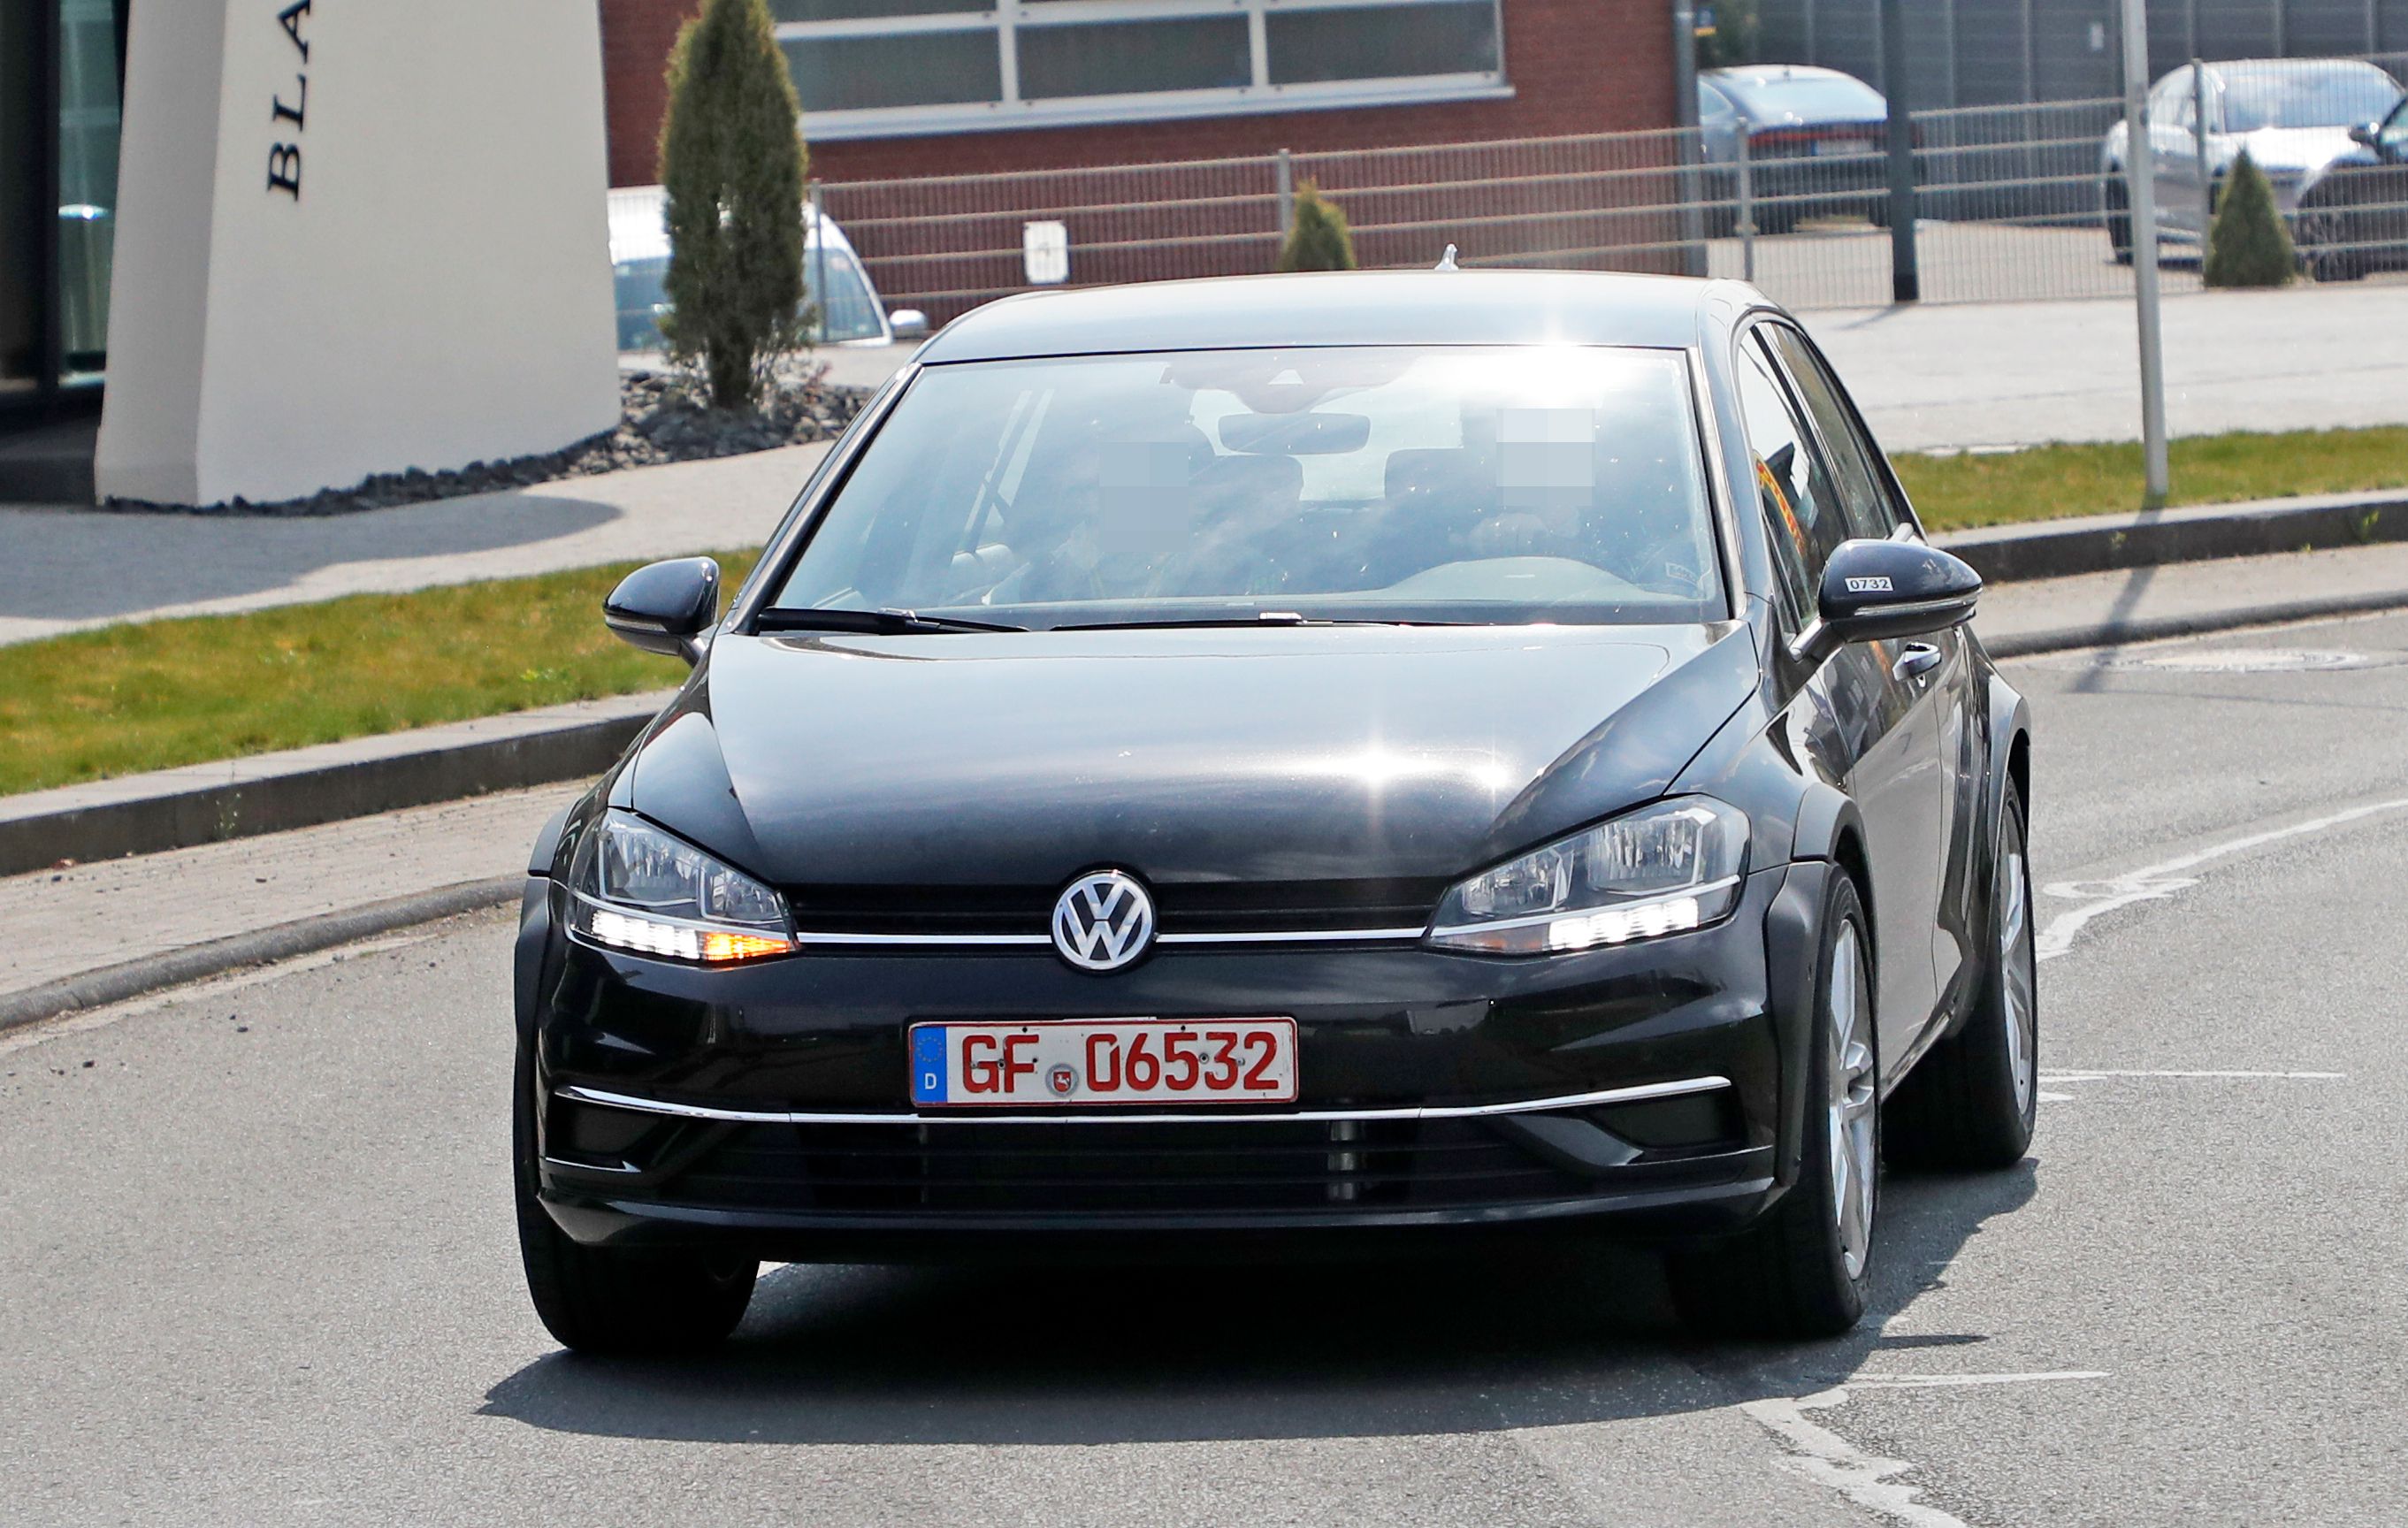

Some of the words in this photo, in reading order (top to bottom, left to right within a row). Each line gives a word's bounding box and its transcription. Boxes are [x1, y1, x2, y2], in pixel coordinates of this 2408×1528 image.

[268, 0, 311, 202] BLA
[1849, 578, 1890, 590] 0732
[1057, 875, 1150, 966] VW
[924, 1073, 937, 1089] D
[961, 1034, 1040, 1093] GF
[1085, 1031, 1279, 1091] 06532
